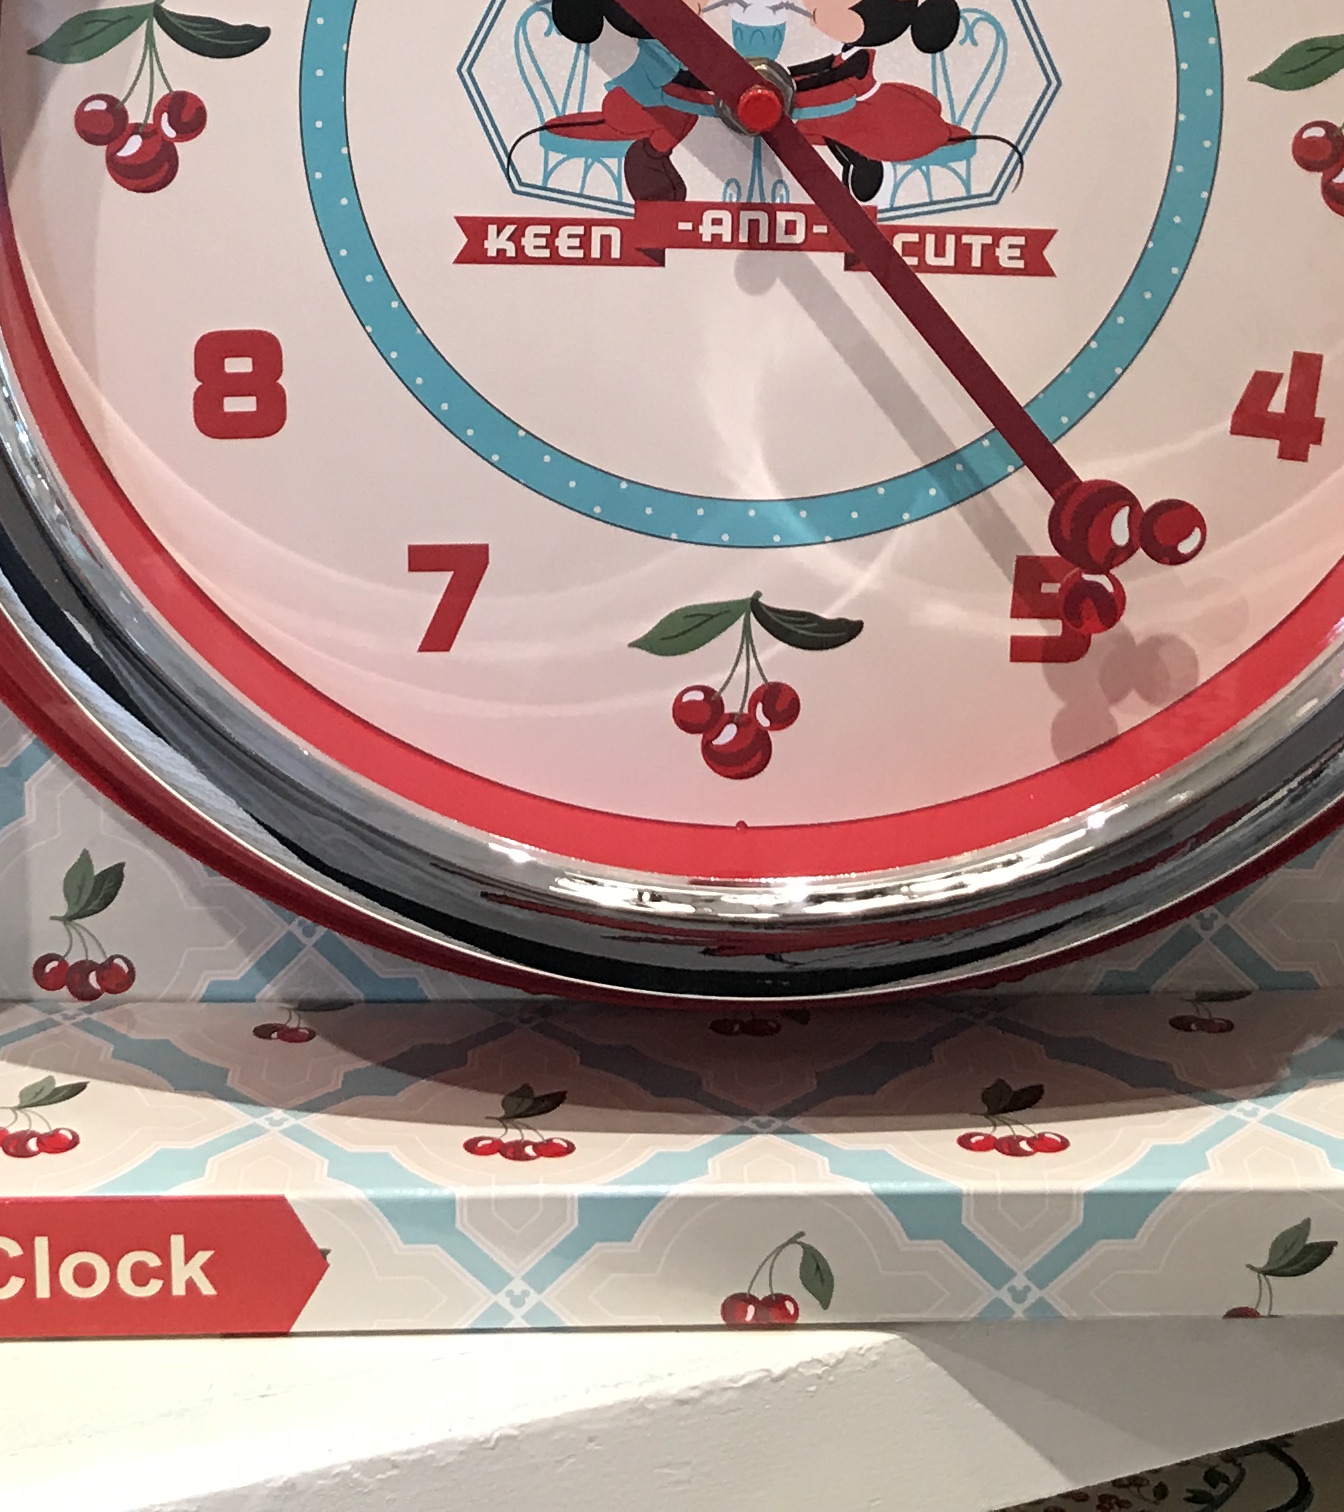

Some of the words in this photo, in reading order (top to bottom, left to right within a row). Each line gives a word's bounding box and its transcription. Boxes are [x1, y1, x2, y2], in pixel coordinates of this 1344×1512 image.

[483, 223, 622, 260] KEEN
[892, 233, 1026, 270] CUTE
[192, 329, 288, 440] 8
[1229, 350, 1325, 463] 4
[407, 543, 490, 653] 7
